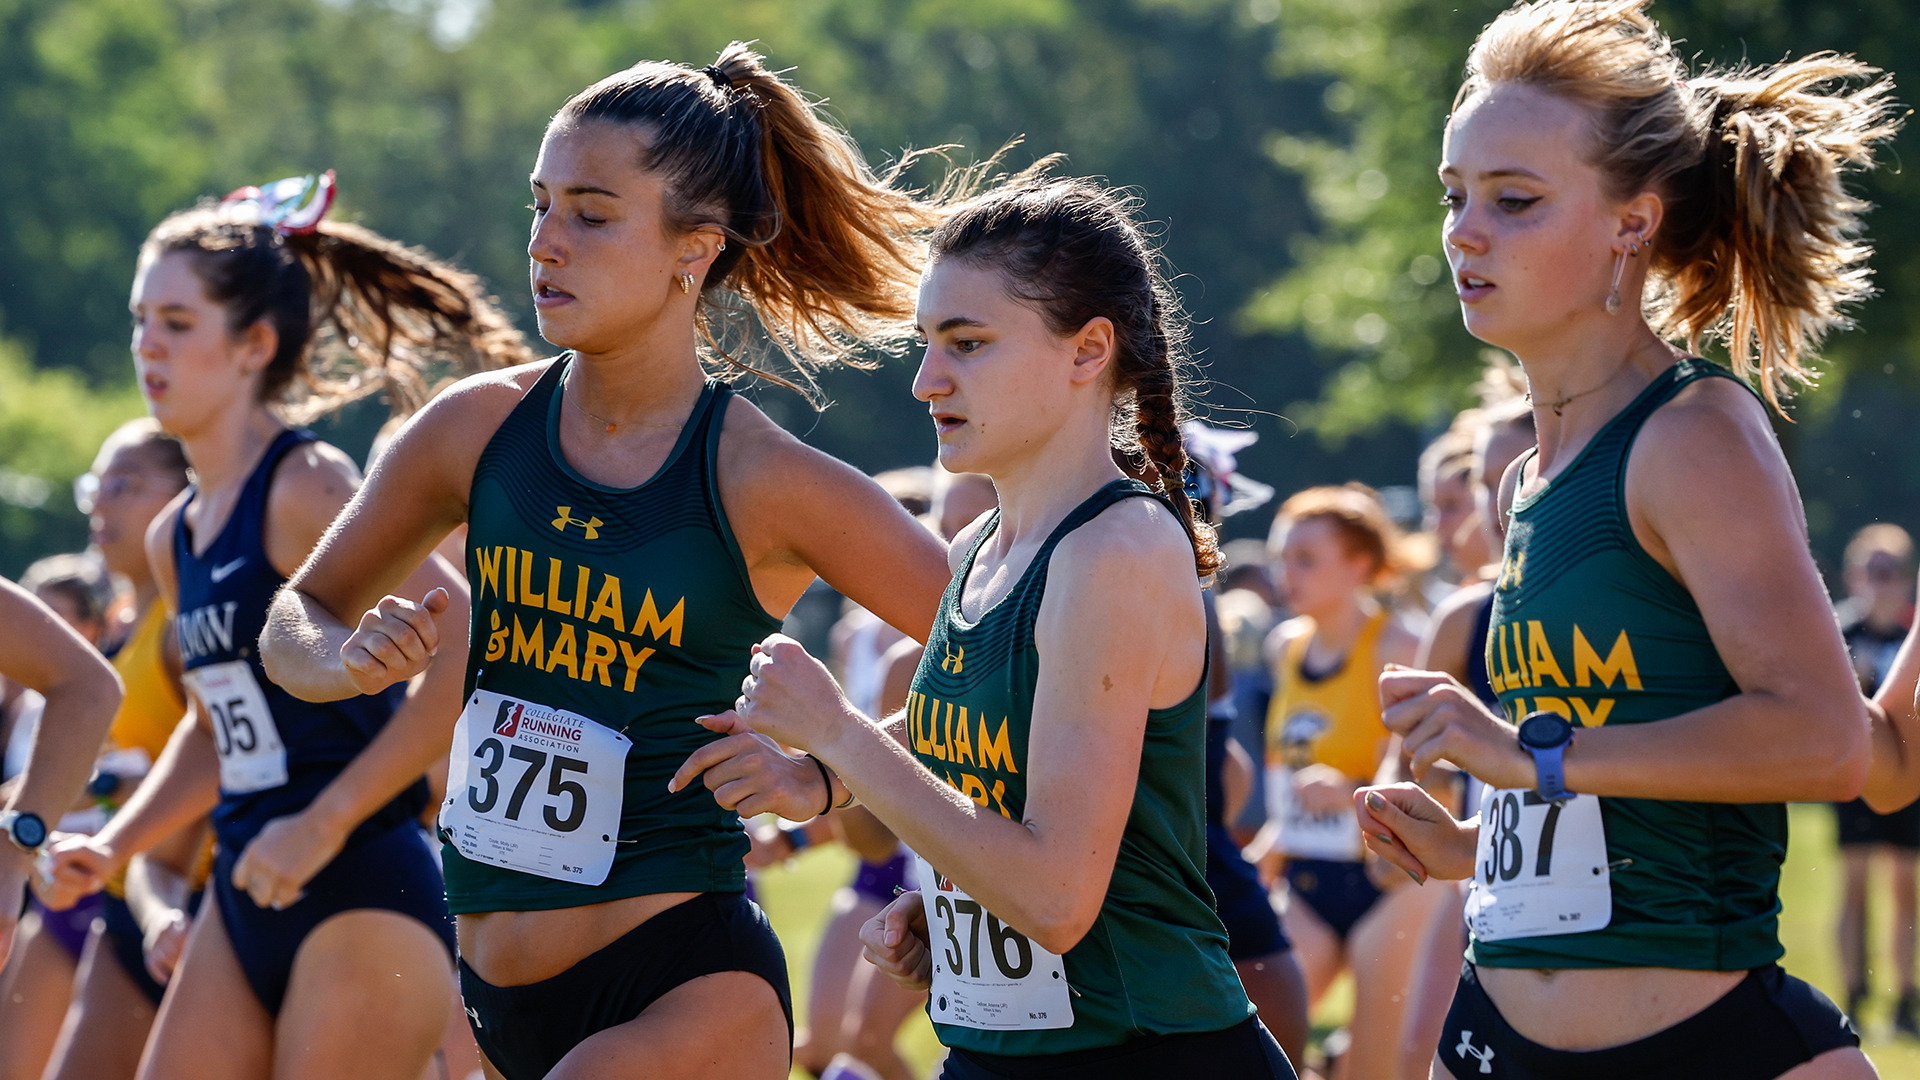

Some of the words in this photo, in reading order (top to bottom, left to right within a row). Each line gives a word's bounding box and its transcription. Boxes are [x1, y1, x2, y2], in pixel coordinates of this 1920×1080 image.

[475, 545, 685, 647] WILLIAM
[1485, 620, 1644, 694] LLIAM
[211, 699, 256, 756] 05
[518, 734, 580, 753] ASSOCIATION
[521, 717, 582, 741] RUNNING
[525, 707, 586, 728] COLLEGIATE
[906, 690, 1019, 774] ILLIAM
[468, 737, 588, 832] 375
[562, 864, 571, 872] No.
[572, 866, 583, 874] 375
[1485, 791, 1562, 885] 387
[935, 895, 1033, 979] 376
[1029, 1012, 1038, 1020] No.
[1038, 1012, 1047, 1020] 376
